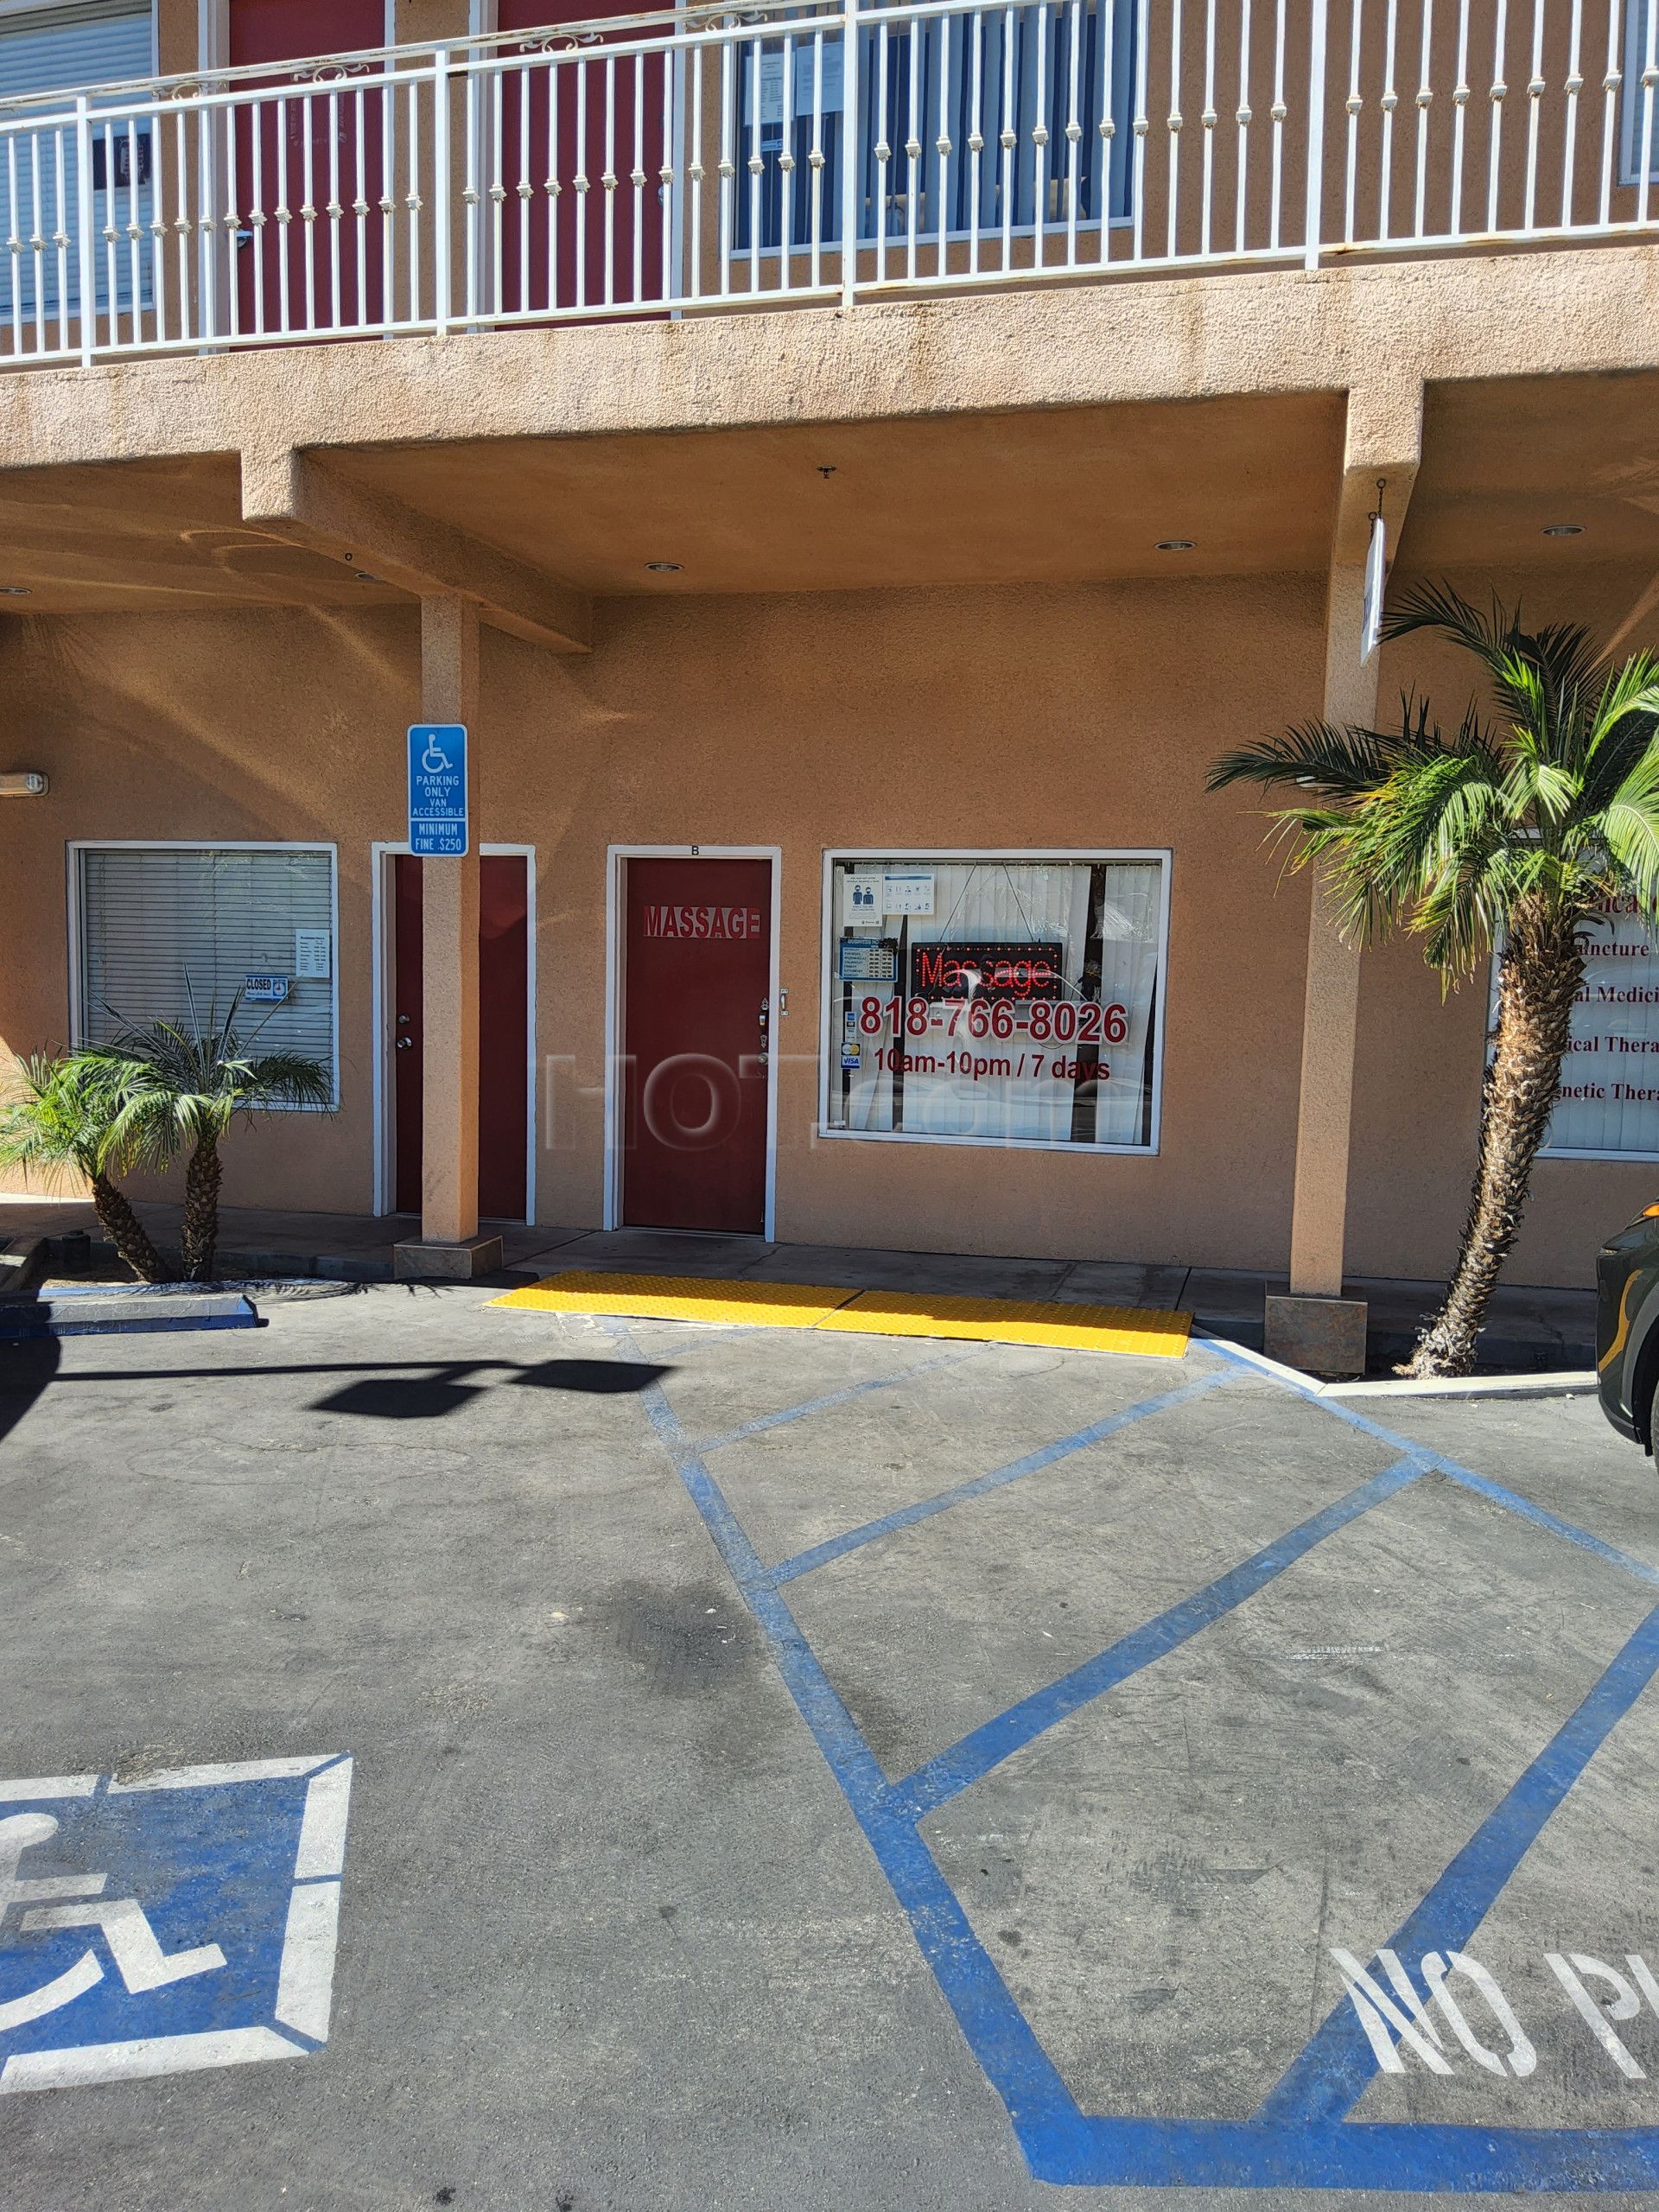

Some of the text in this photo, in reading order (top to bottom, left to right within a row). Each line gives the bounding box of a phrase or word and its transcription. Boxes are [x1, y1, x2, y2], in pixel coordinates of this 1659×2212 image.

[416, 776, 460, 786] PARKING
[424, 787, 451, 797] ONLY
[429, 798, 447, 807] VAN
[412, 808, 464, 817] ACCESSIBLE
[419, 823, 458, 836] MINIMUM
[416, 837, 461, 850] FINE $250
[691, 846, 699, 855] B
[643, 906, 760, 939] MASSAGE
[1579, 942, 1649, 956] uncture
[922, 951, 1051, 996] Massage
[247, 978, 271, 990] CLOSED
[1574, 986, 1590, 1002] al
[860, 995, 1128, 1046] 818-766-8026
[1567, 1036, 1599, 1052] ical
[874, 1047, 1011, 1080] 10am-10pm
[1031, 1054, 1045, 1077] 7
[1052, 1054, 1110, 1081] days
[1330, 1948, 1537, 2077] NO
